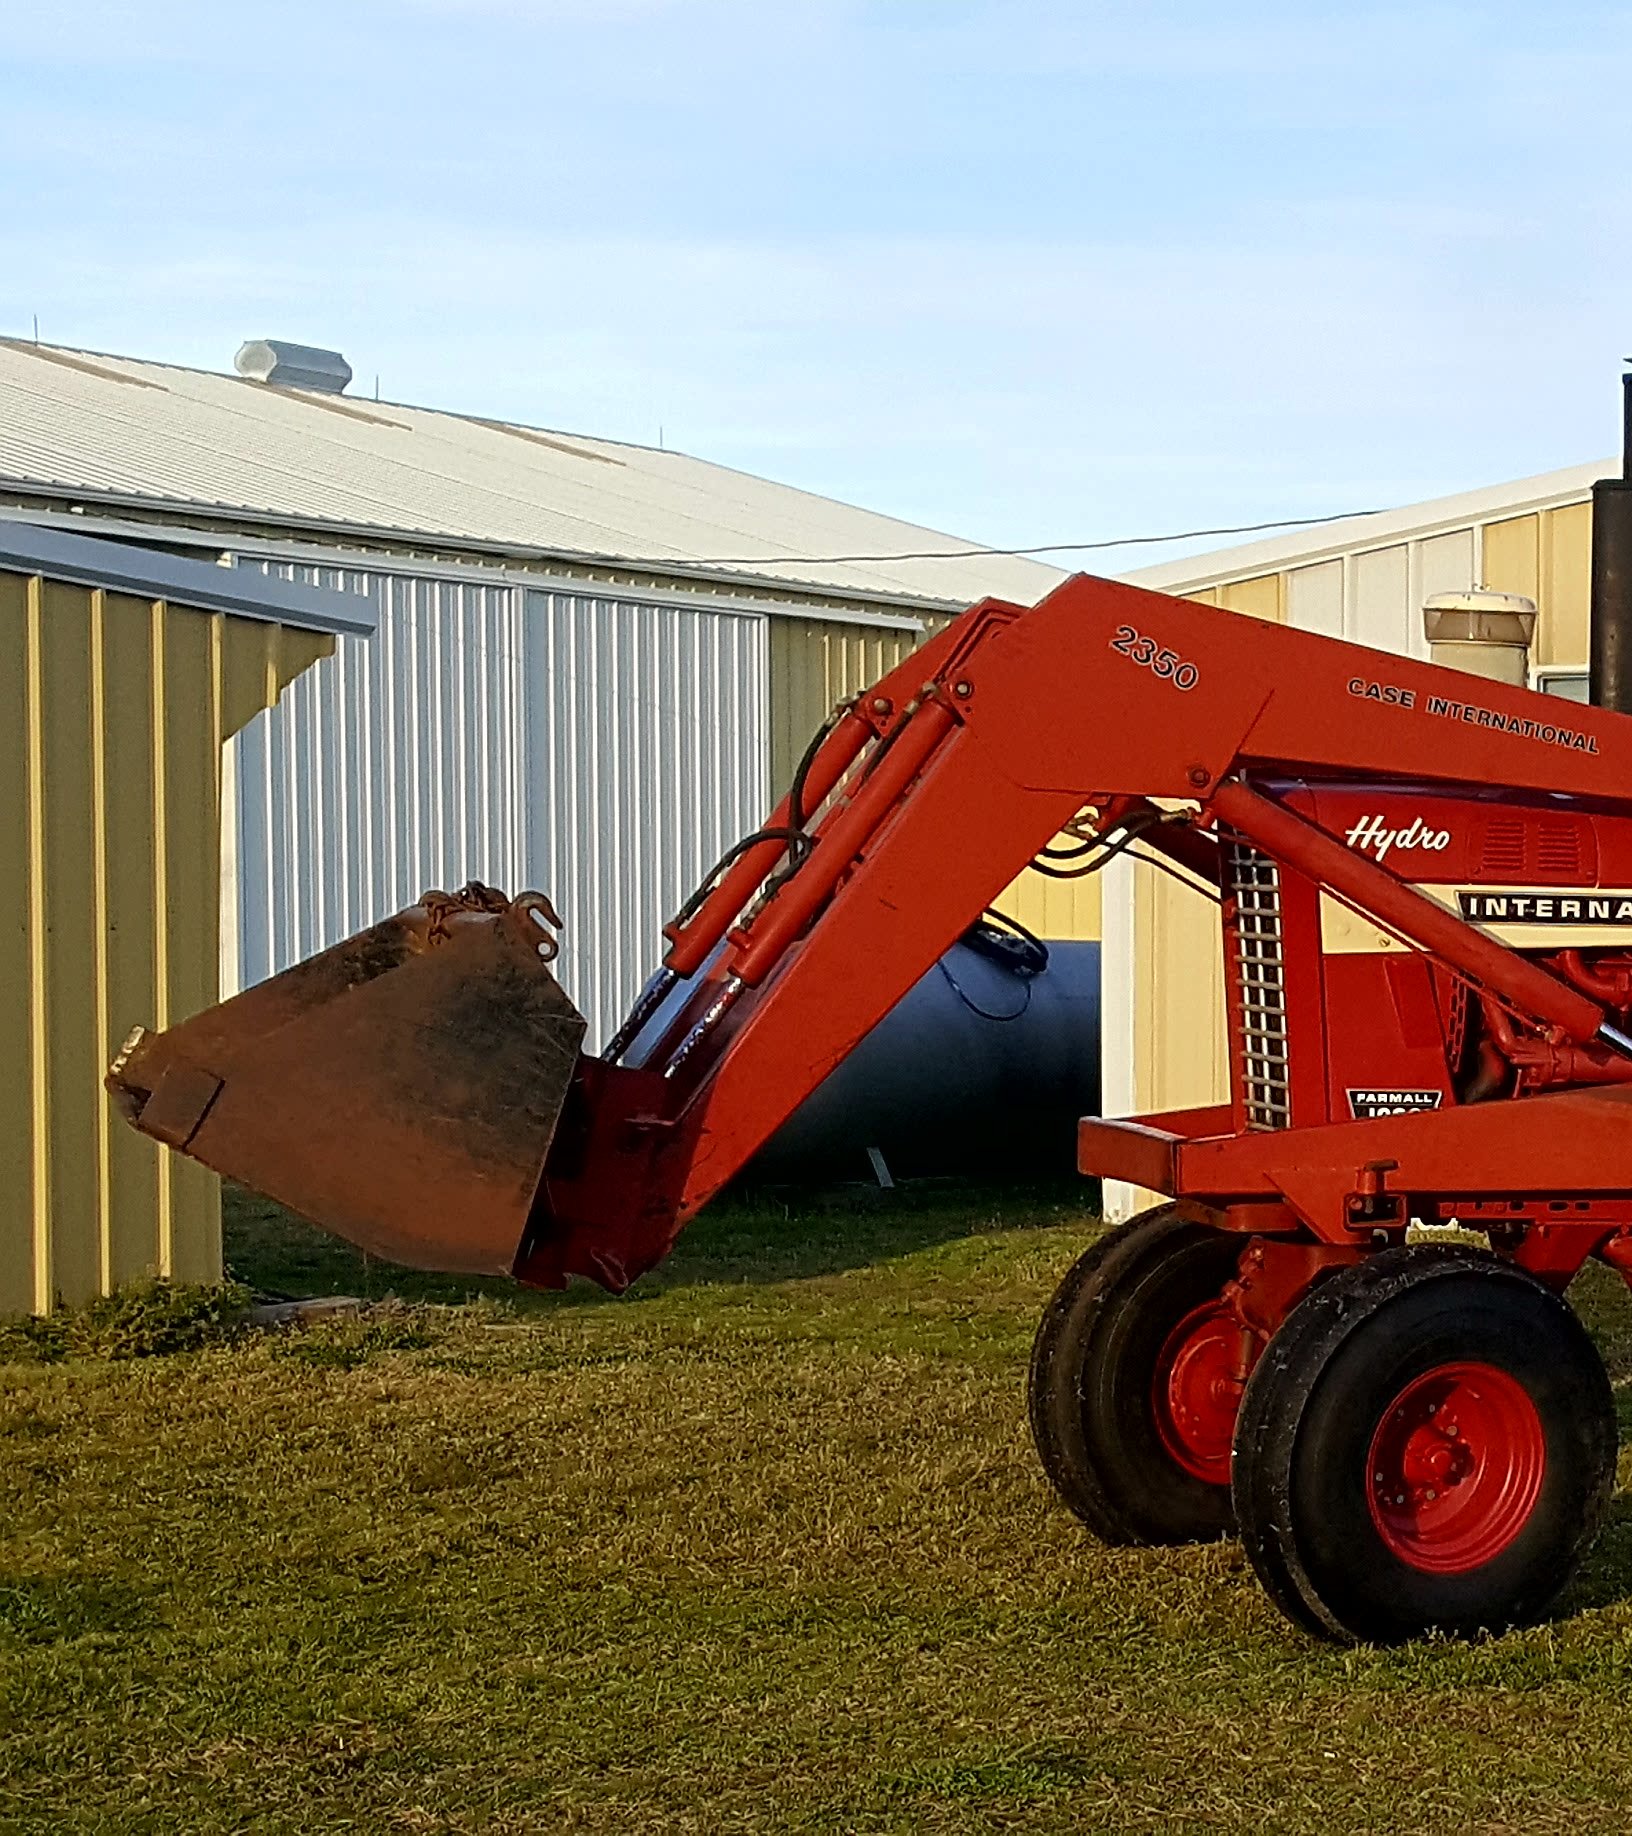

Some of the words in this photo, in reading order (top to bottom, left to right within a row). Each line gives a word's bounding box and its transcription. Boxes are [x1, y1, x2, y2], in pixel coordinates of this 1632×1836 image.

[1109, 625, 1199, 691] 2350
[1347, 677, 1416, 708] CASE
[1425, 695, 1600, 754] INTERNATIONAL
[1345, 814, 1450, 862] Hydro
[1357, 1093, 1433, 1103] FARMALL
